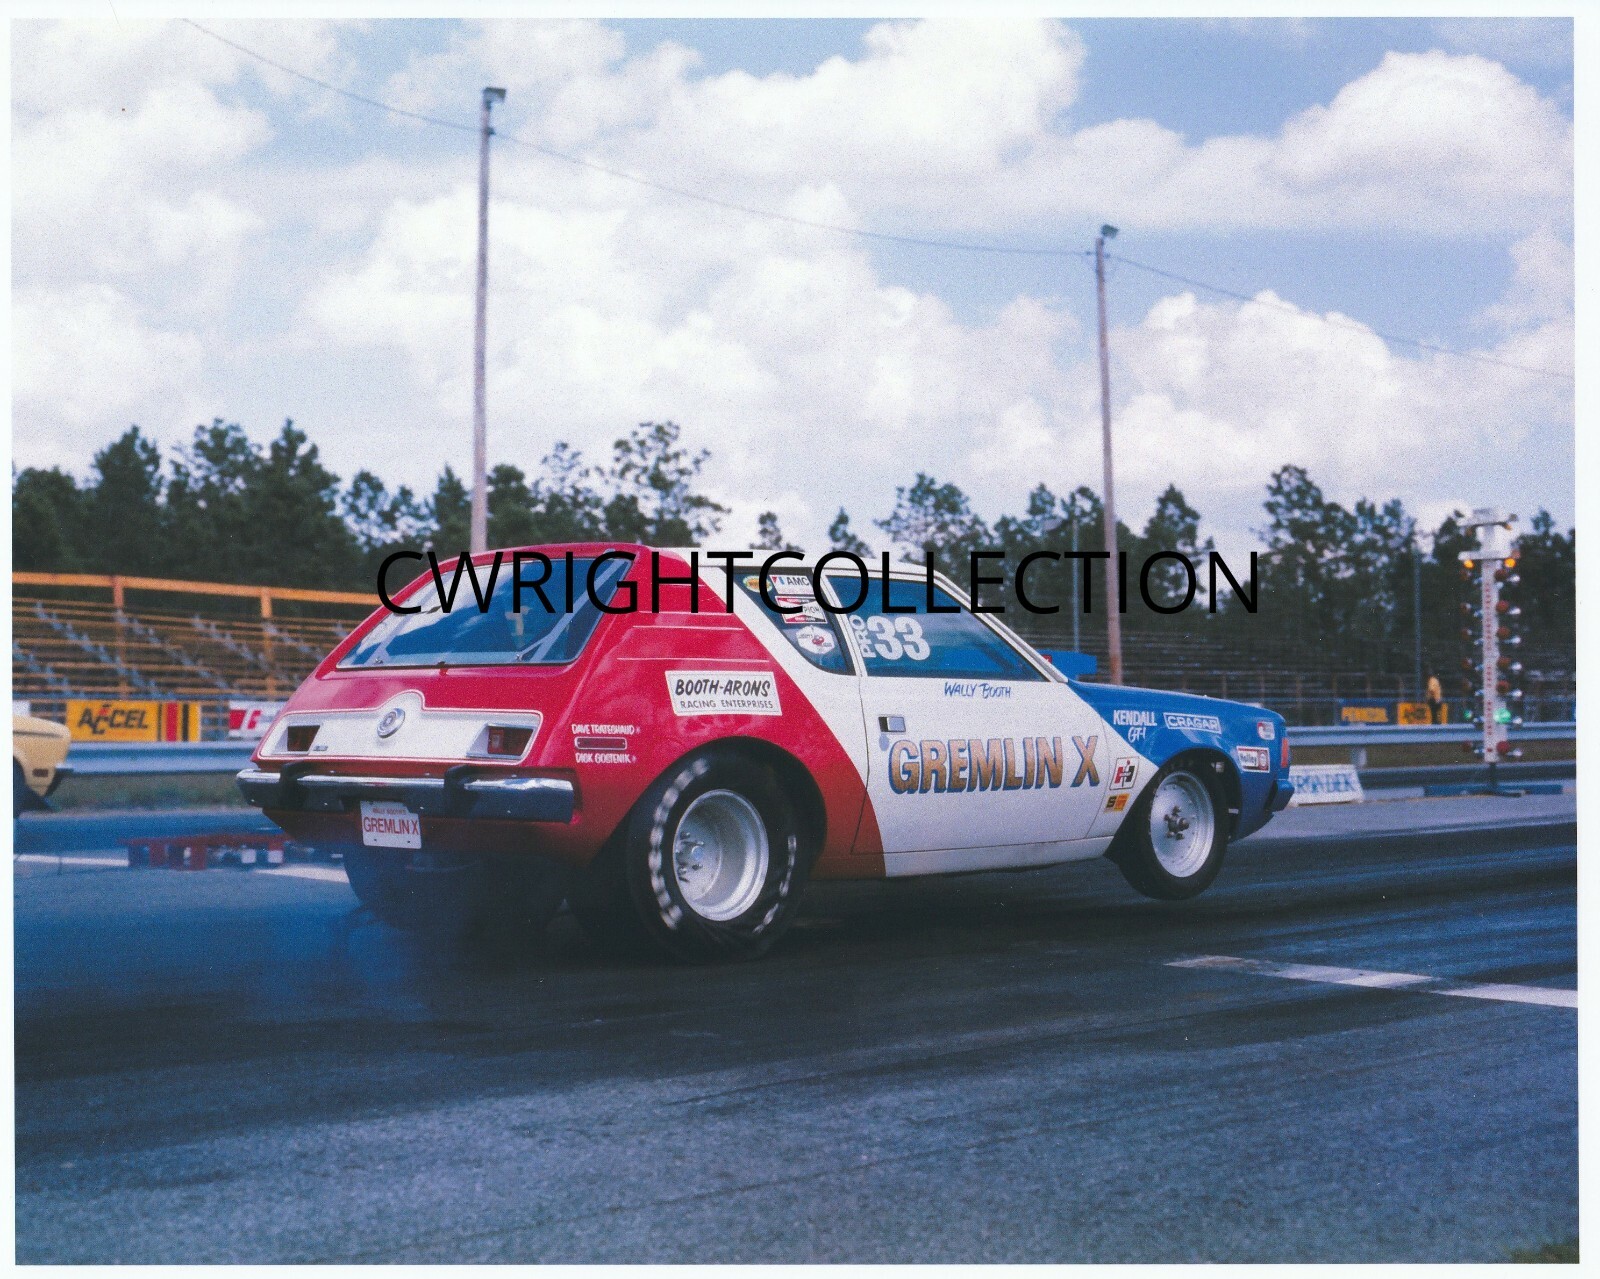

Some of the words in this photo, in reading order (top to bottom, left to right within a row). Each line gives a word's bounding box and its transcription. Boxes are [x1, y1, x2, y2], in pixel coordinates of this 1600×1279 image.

[786, 577, 809, 586] AMC
[866, 615, 930, 661] 33
[674, 678, 771, 698] BOOTH-ARONS
[944, 682, 977, 697] WALLY
[978, 683, 1011, 699] BOOTH
[680, 700, 716, 709] RACING
[721, 700, 774, 709] ENTERPRISES
[78, 704, 149, 735] ACCEL
[1113, 710, 1157, 726] KENDALL
[1167, 715, 1219, 731] CRAGAR
[571, 724, 590, 735] DAVE
[888, 736, 1063, 795] GREMLIN
[1070, 735, 1099, 787] X
[363, 816, 410, 835] GREMLIN
[411, 819, 420, 835] X
